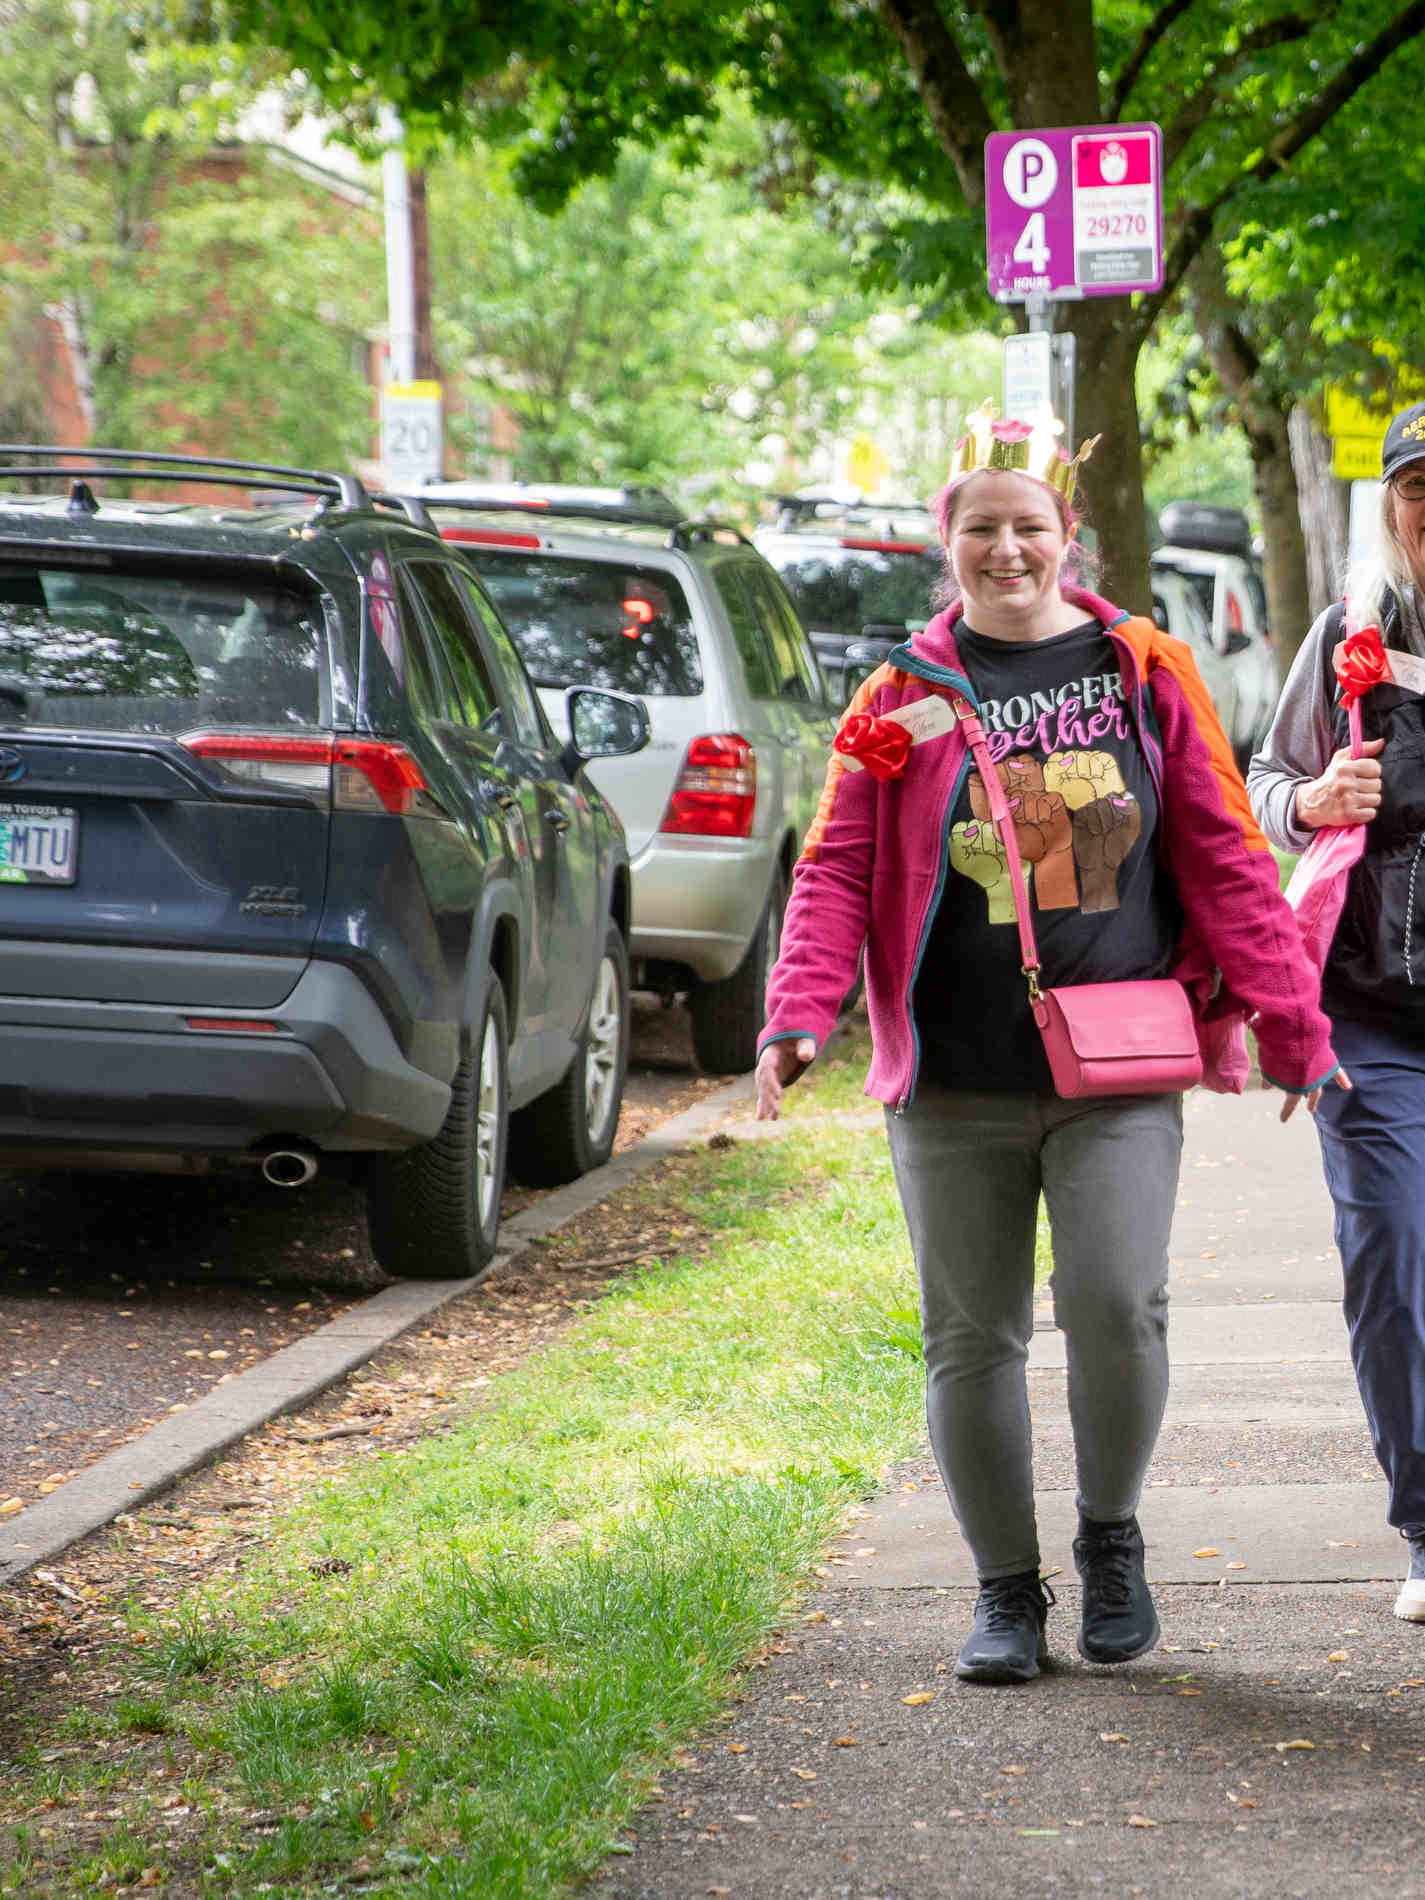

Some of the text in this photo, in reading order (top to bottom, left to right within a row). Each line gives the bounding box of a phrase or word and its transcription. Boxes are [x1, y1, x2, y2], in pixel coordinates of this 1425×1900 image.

[1021, 153, 1044, 194] P
[1013, 212, 1051, 273] 4
[1086, 214, 1147, 239] 29270
[389, 416, 433, 455] 20
[976, 672, 1125, 734] RONGER
[984, 696, 1128, 764] gether
[14, 804, 58, 816] TOYOTA
[10, 825, 70, 866] MTU
